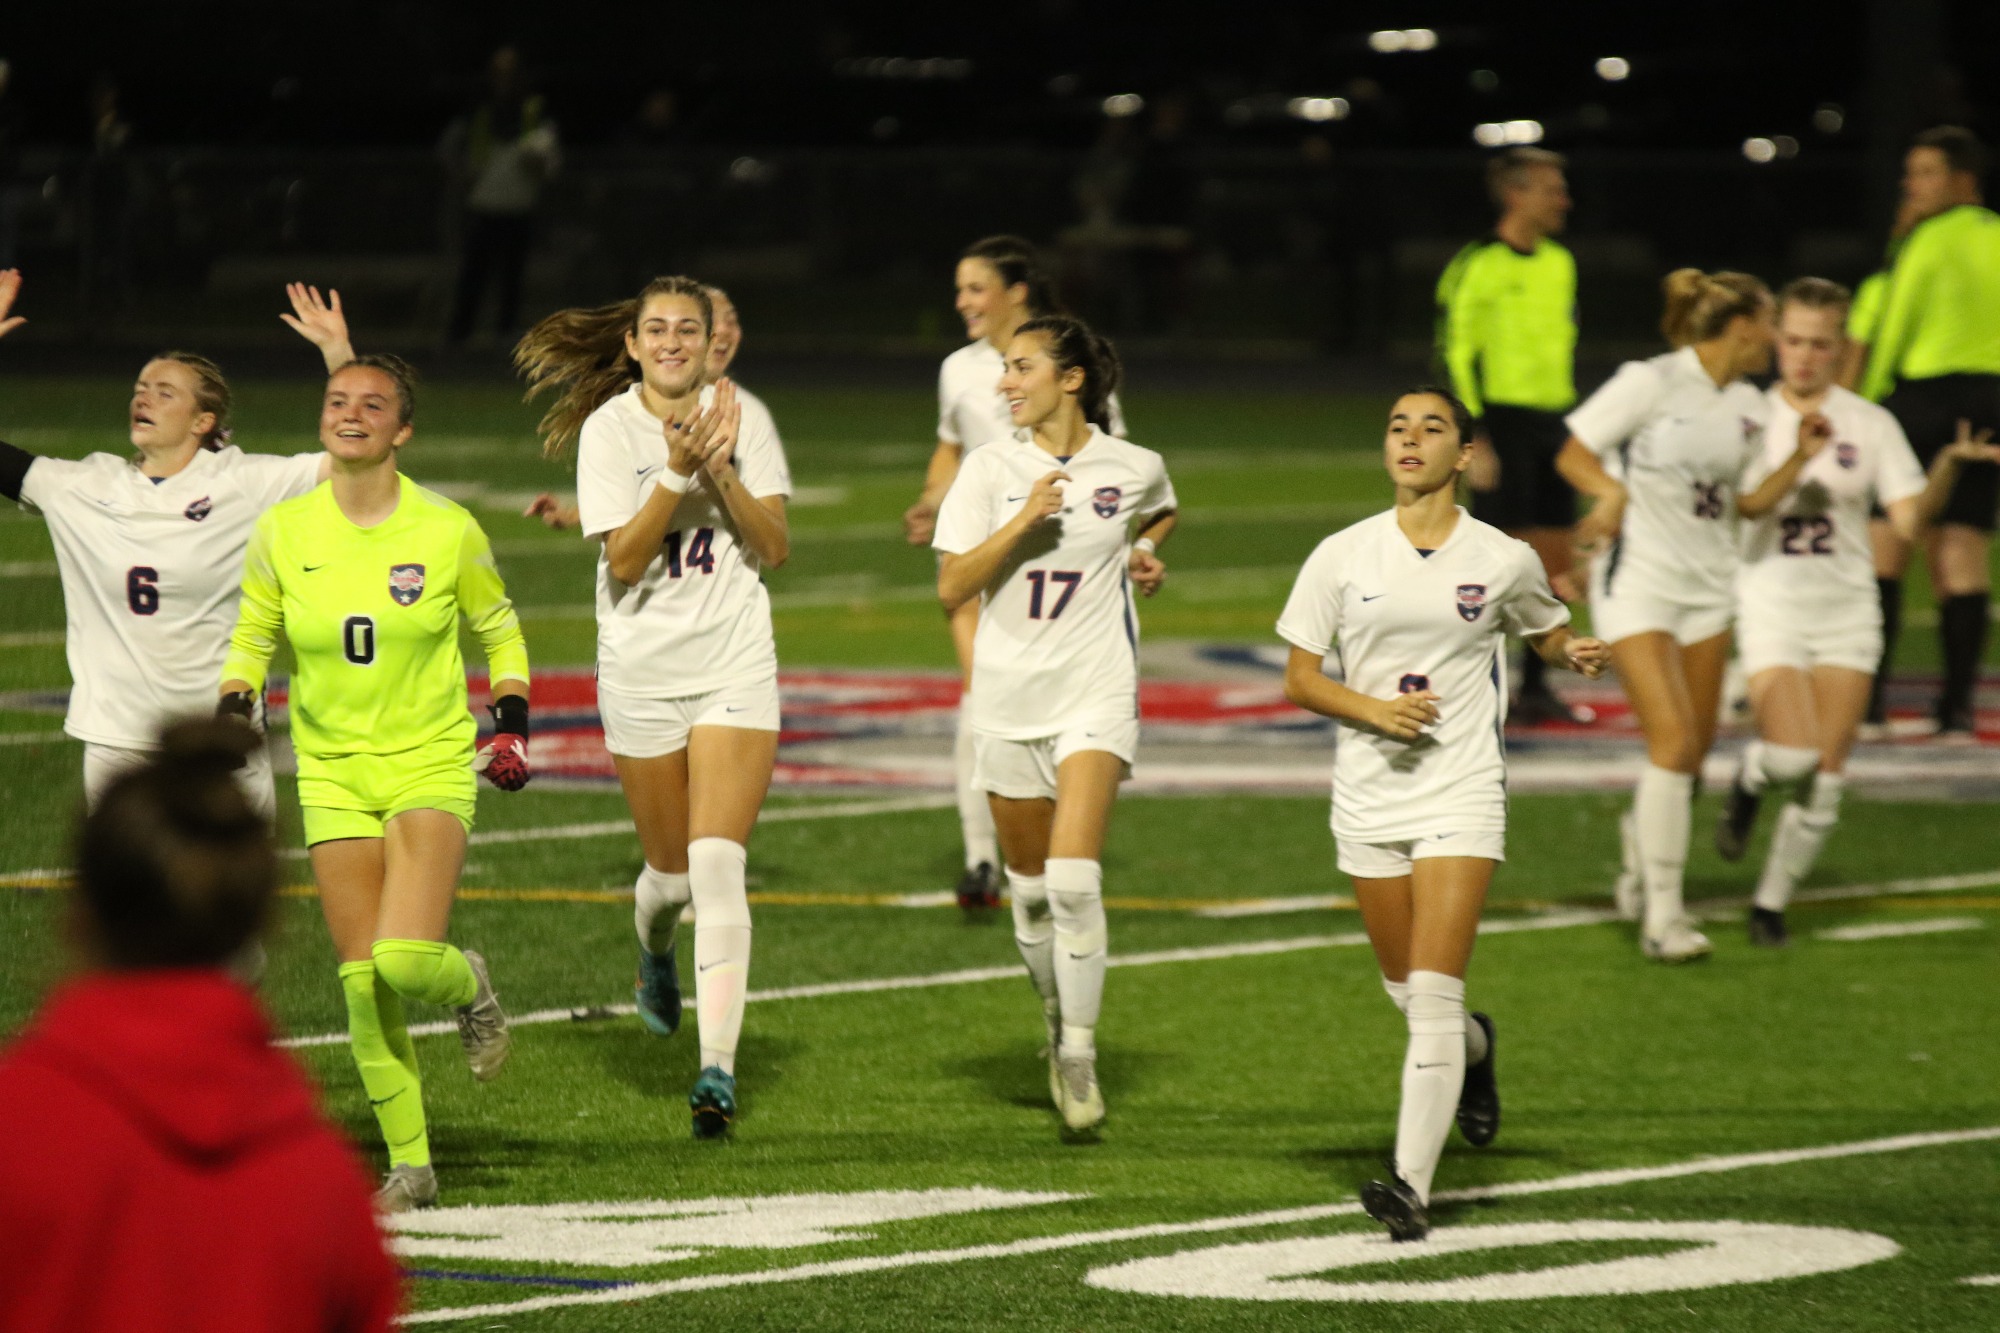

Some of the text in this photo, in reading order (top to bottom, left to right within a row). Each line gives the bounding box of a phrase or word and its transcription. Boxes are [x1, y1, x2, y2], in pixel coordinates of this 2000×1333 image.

[663, 527, 715, 578] 14
[1780, 515, 1834, 554] 22
[126, 566, 159, 615] 6
[1026, 569, 1083, 619] 17
[343, 615, 375, 665] 0
